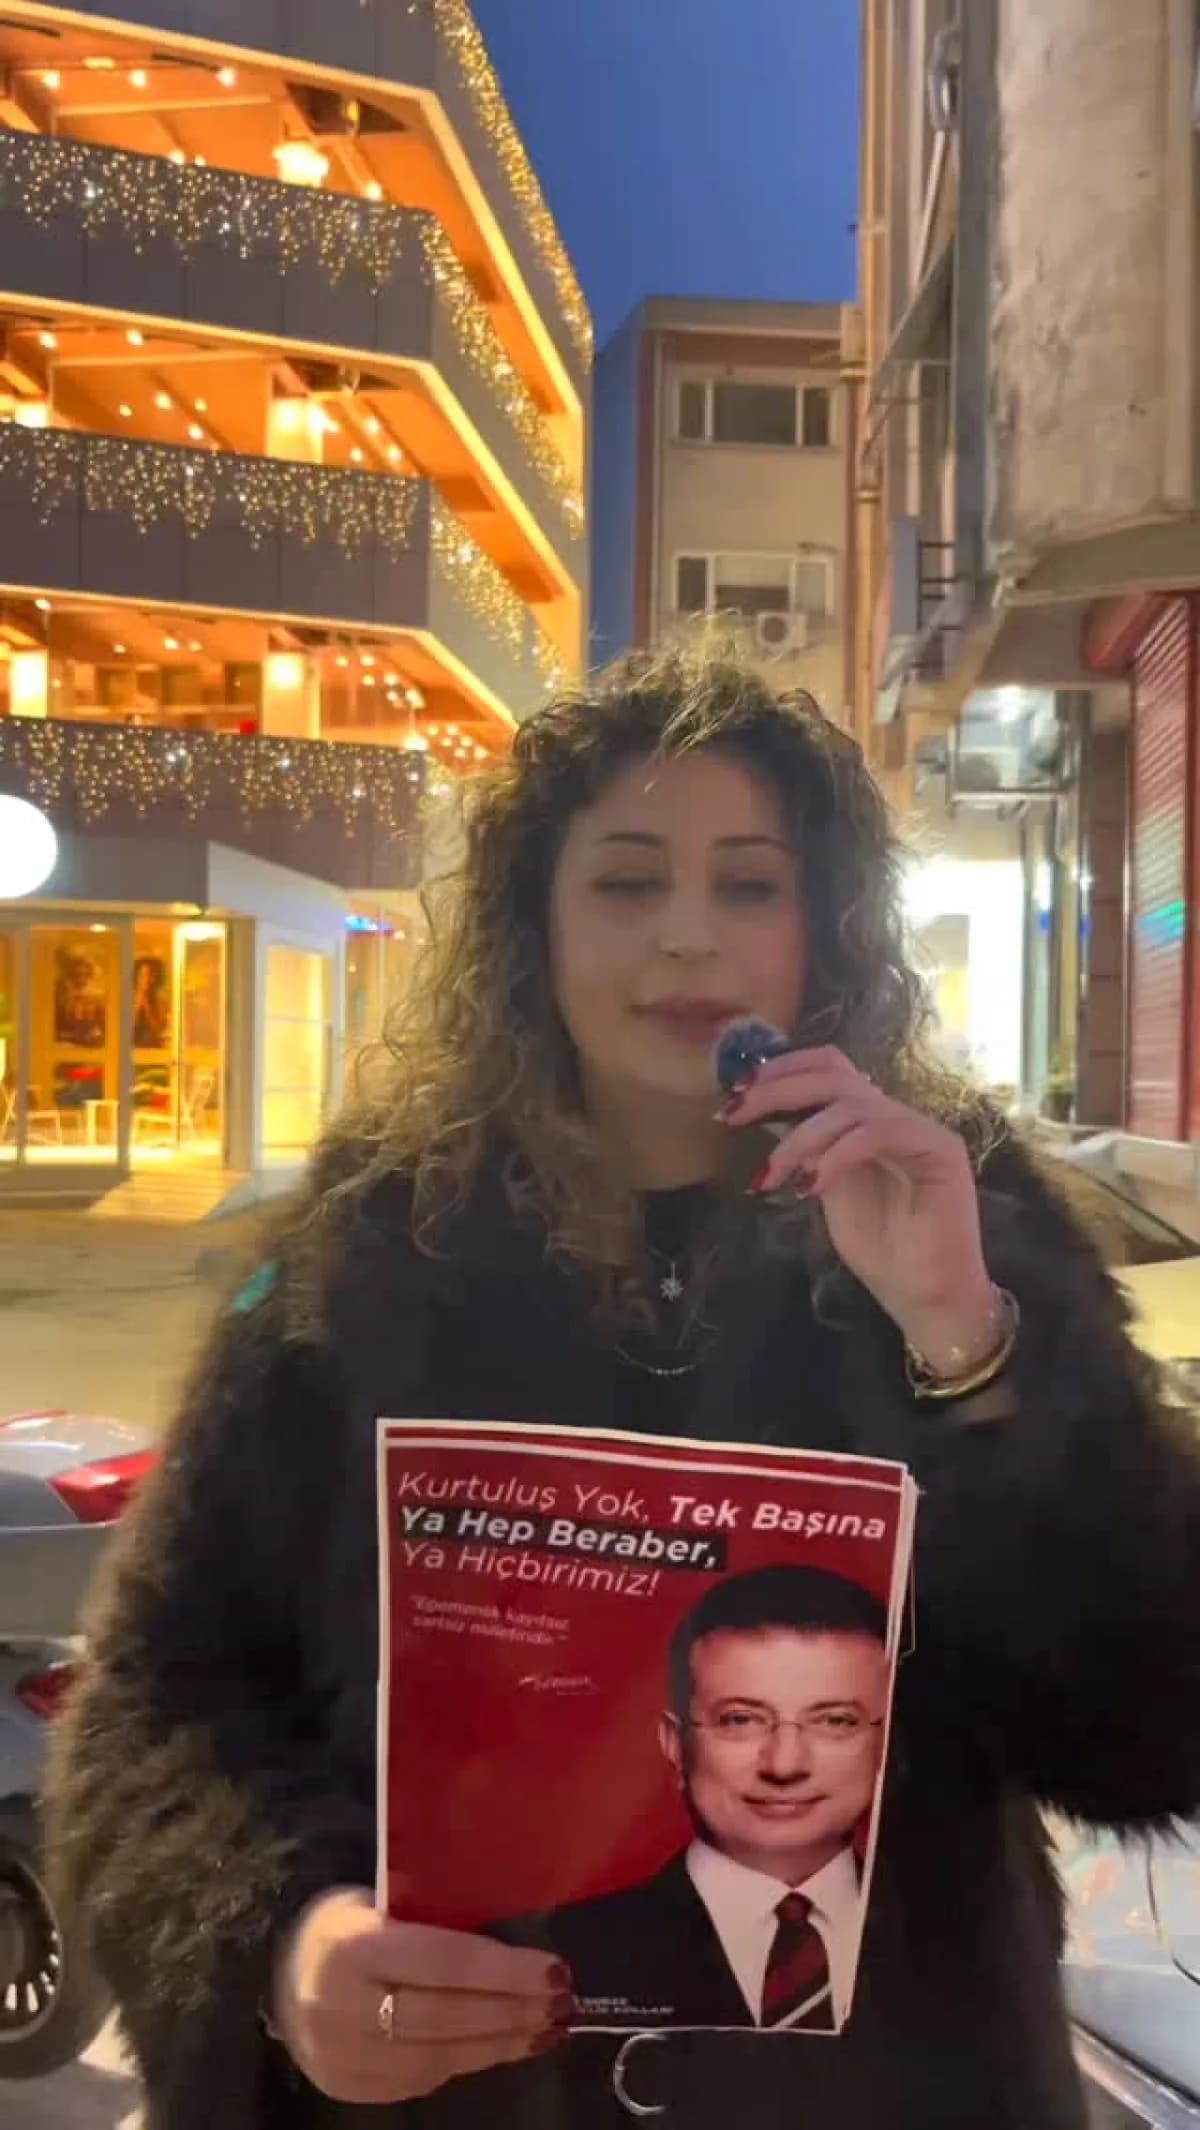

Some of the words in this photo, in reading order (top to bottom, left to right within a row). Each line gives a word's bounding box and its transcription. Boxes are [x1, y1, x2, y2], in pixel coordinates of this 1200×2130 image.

[398, 1471, 559, 1511] Kurtuluş
[575, 1484, 650, 1523] Yok,
[670, 1495, 741, 1528] Tek
[752, 1502, 885, 1538] Başına
[402, 1506, 445, 1532] Ya
[457, 1509, 534, 1545] Hep
[547, 1519, 716, 1568] Beraber,
[402, 1541, 444, 1568] Ya
[457, 1545, 661, 1596] Hiçbirimiz!
